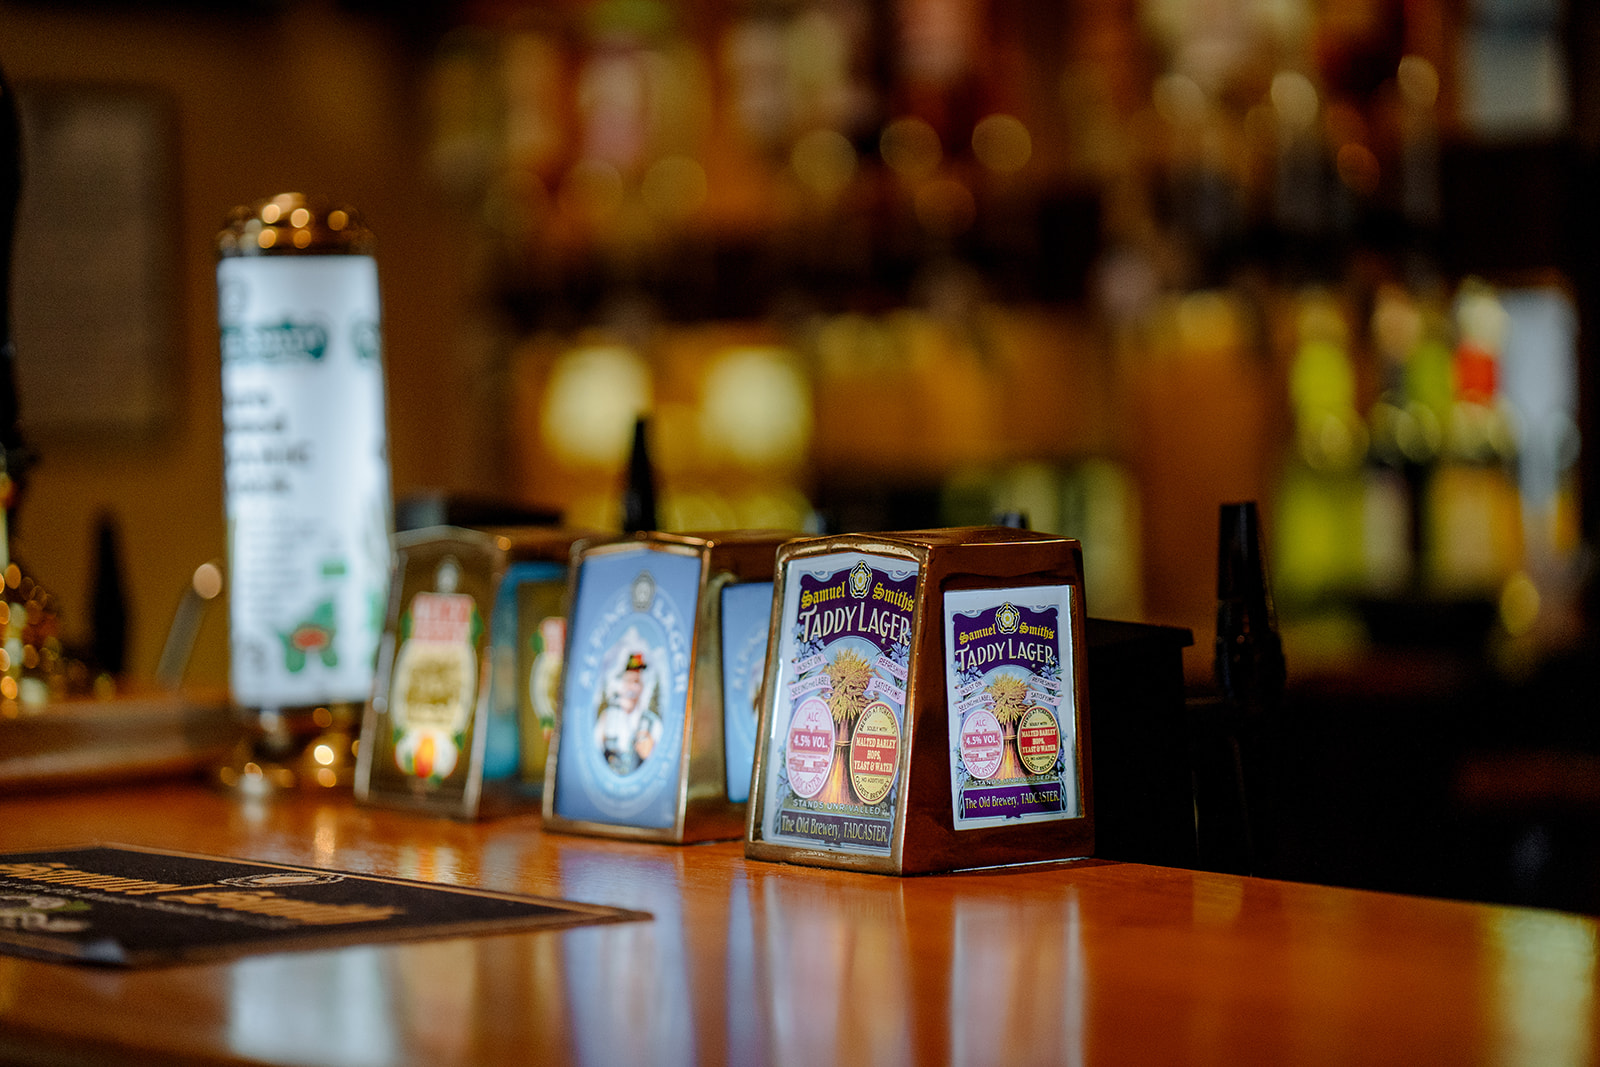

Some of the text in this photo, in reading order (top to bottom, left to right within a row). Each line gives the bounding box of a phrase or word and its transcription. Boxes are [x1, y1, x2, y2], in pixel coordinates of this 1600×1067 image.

[801, 581, 915, 612] Samuel Smith's
[799, 602, 911, 646] TADDY LAGER
[959, 622, 1055, 645] Samuel Smith's
[813, 655, 822, 665] ON
[955, 639, 1054, 671] TADDY LAGER
[878, 657, 908, 678] REFRESHING
[815, 676, 830, 688] LABEL
[874, 680, 902, 700] SATISFYING
[793, 734, 829, 748] 4.5% VOL.
[856, 736, 897, 749] MALTED BARLEY
[965, 734, 999, 746] 4.5% VOL.
[854, 760, 893, 773] YEAST & WATER
[792, 799, 823, 810] STANDS
[826, 802, 881, 816] UNRIVALLED
[965, 797, 978, 809] The
[979, 795, 990, 809] Old
[781, 814, 795, 832] The
[796, 816, 809, 834] Old
[810, 818, 840, 841] Brewery,
